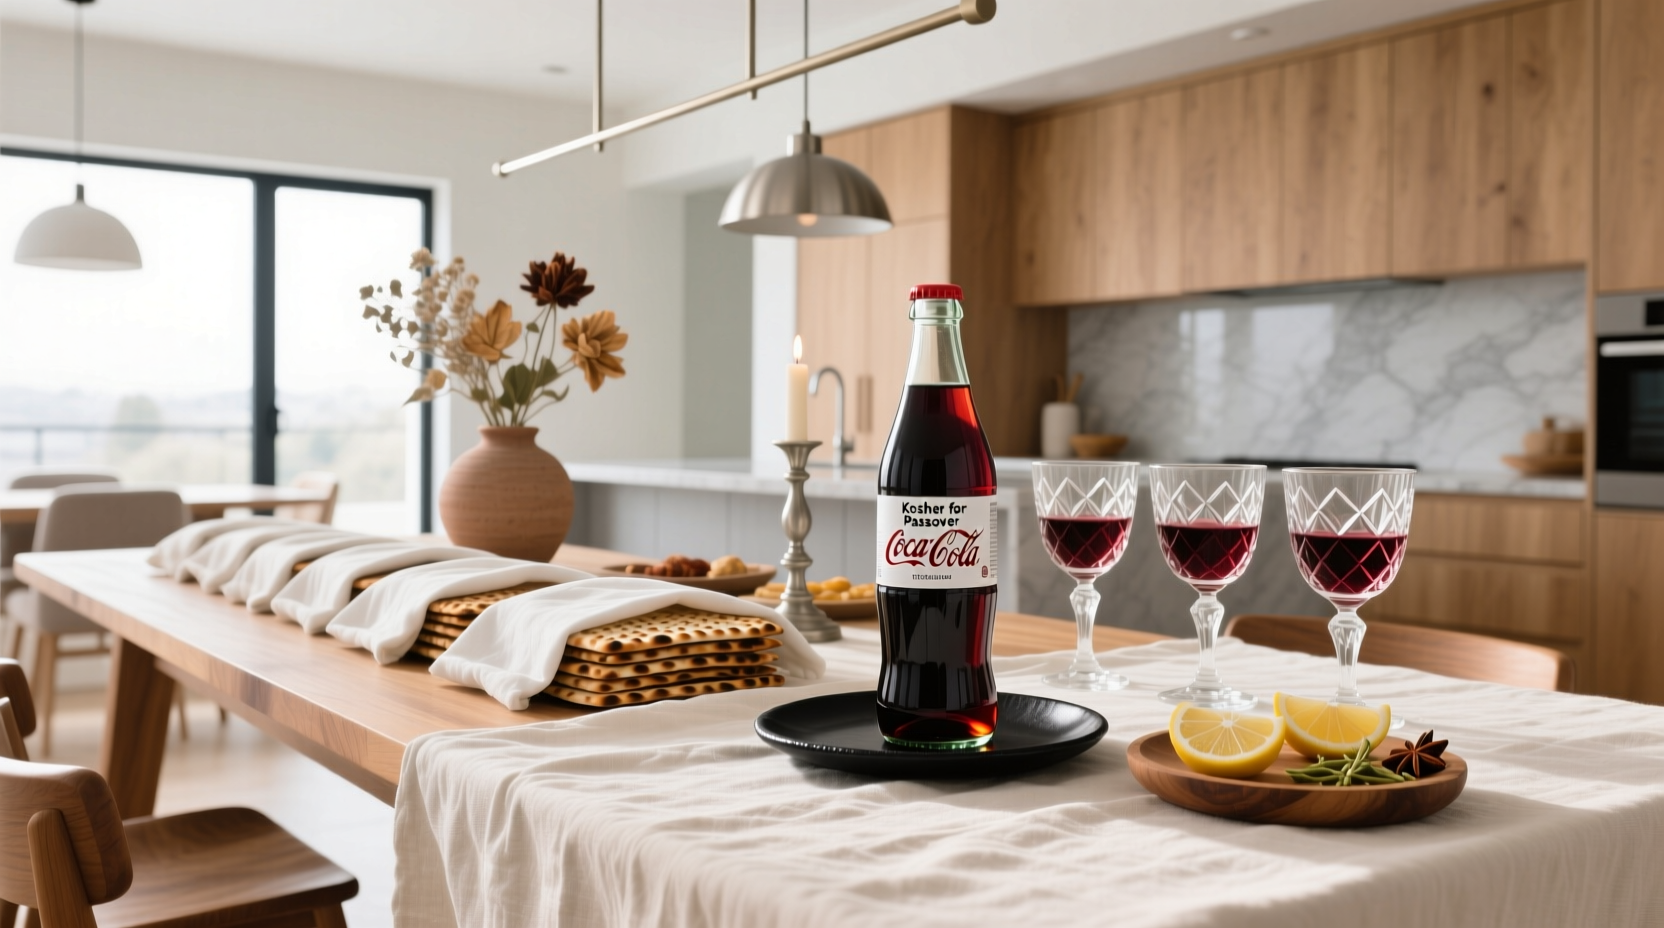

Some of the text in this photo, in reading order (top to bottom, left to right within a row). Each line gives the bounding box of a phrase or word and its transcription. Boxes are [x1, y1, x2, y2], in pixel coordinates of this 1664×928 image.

[902, 502, 967, 514] Kosher for
[904, 515, 960, 527] Passover
